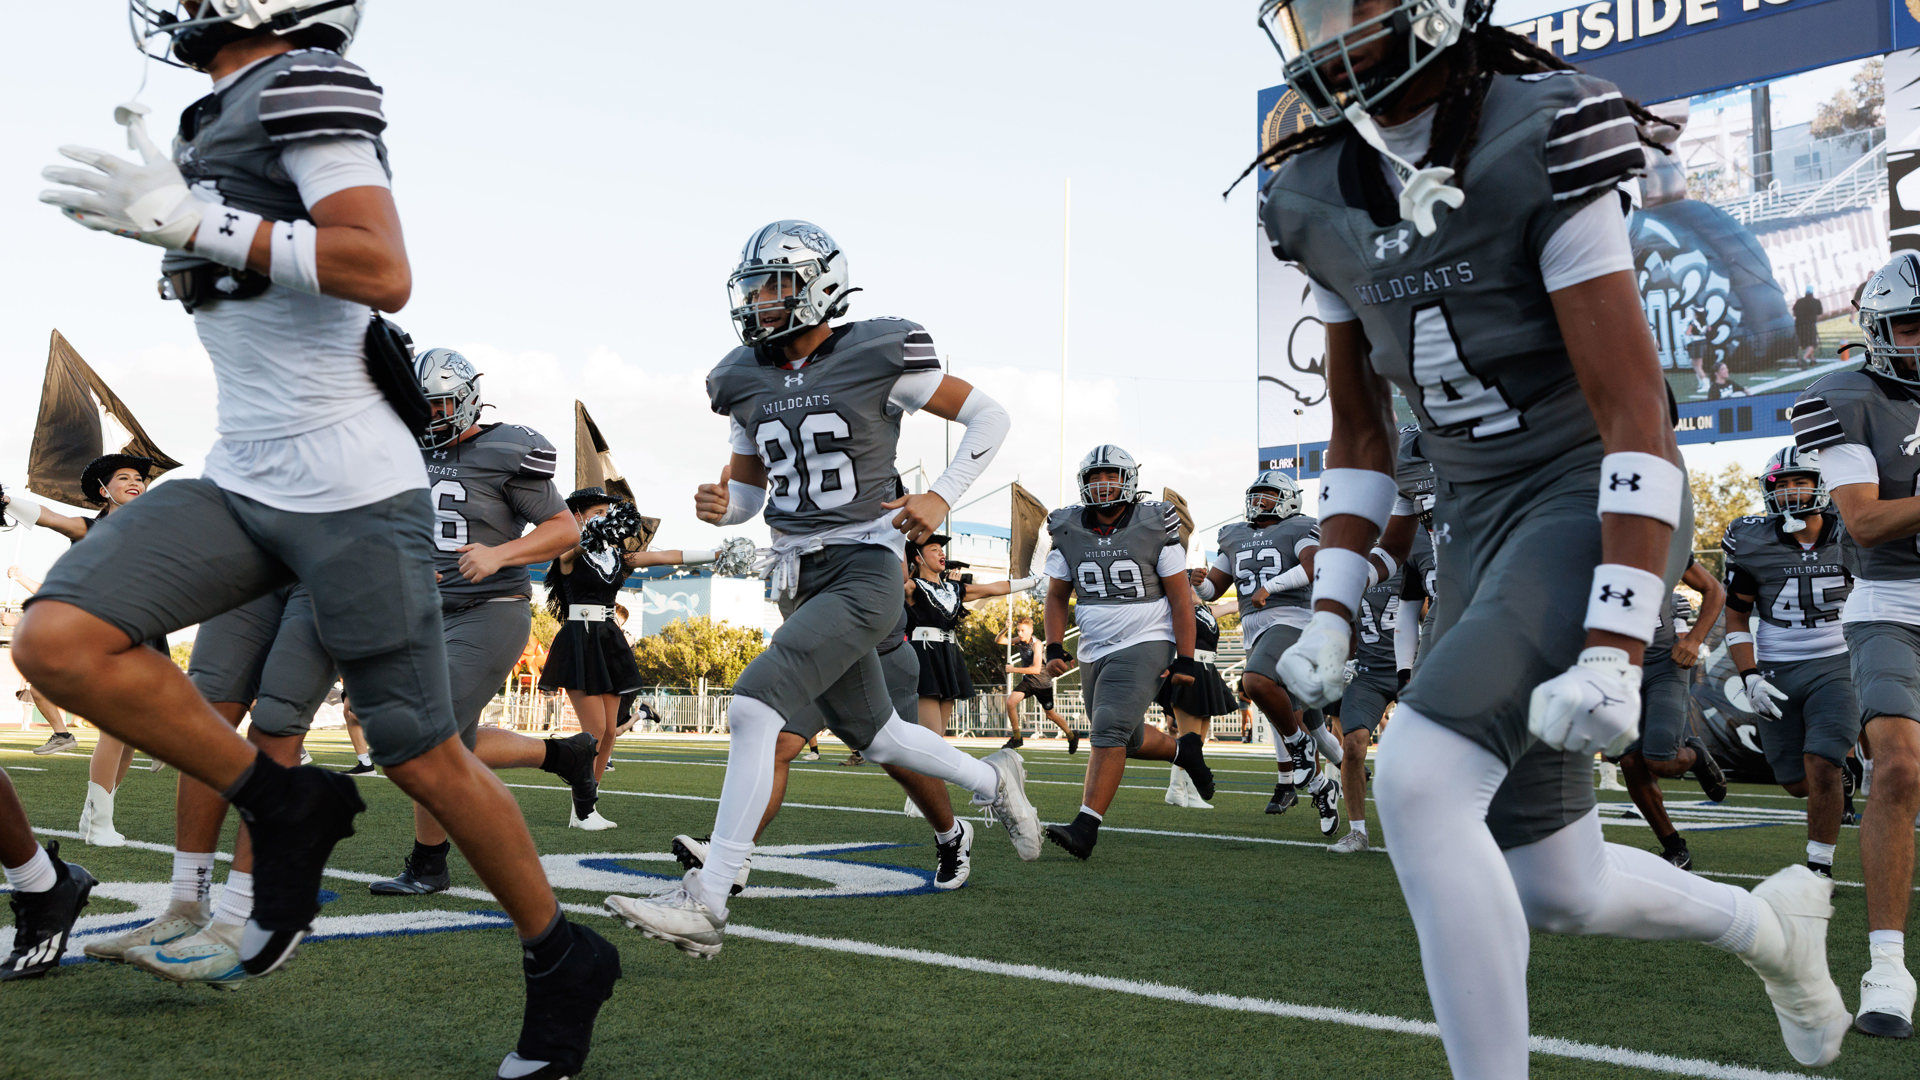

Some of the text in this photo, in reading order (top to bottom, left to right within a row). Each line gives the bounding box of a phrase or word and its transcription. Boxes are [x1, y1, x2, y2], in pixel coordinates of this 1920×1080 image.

[1355, 261, 1474, 306] WILDCATS
[1411, 302, 1524, 439] 4
[763, 395, 830, 415] WILDCATS
[1697, 415, 1713, 429] ON
[755, 411, 858, 513] 86
[1269, 457, 1294, 470] CLARK
[430, 479, 469, 552] 6
[1085, 549, 1129, 558] WILDCATS
[1241, 540, 1273, 549] WILDCATS
[1077, 558, 1146, 599] 99
[1234, 547, 1283, 596] 52
[1783, 565, 1839, 575] WILDCATS
[1771, 575, 1847, 629] 45
